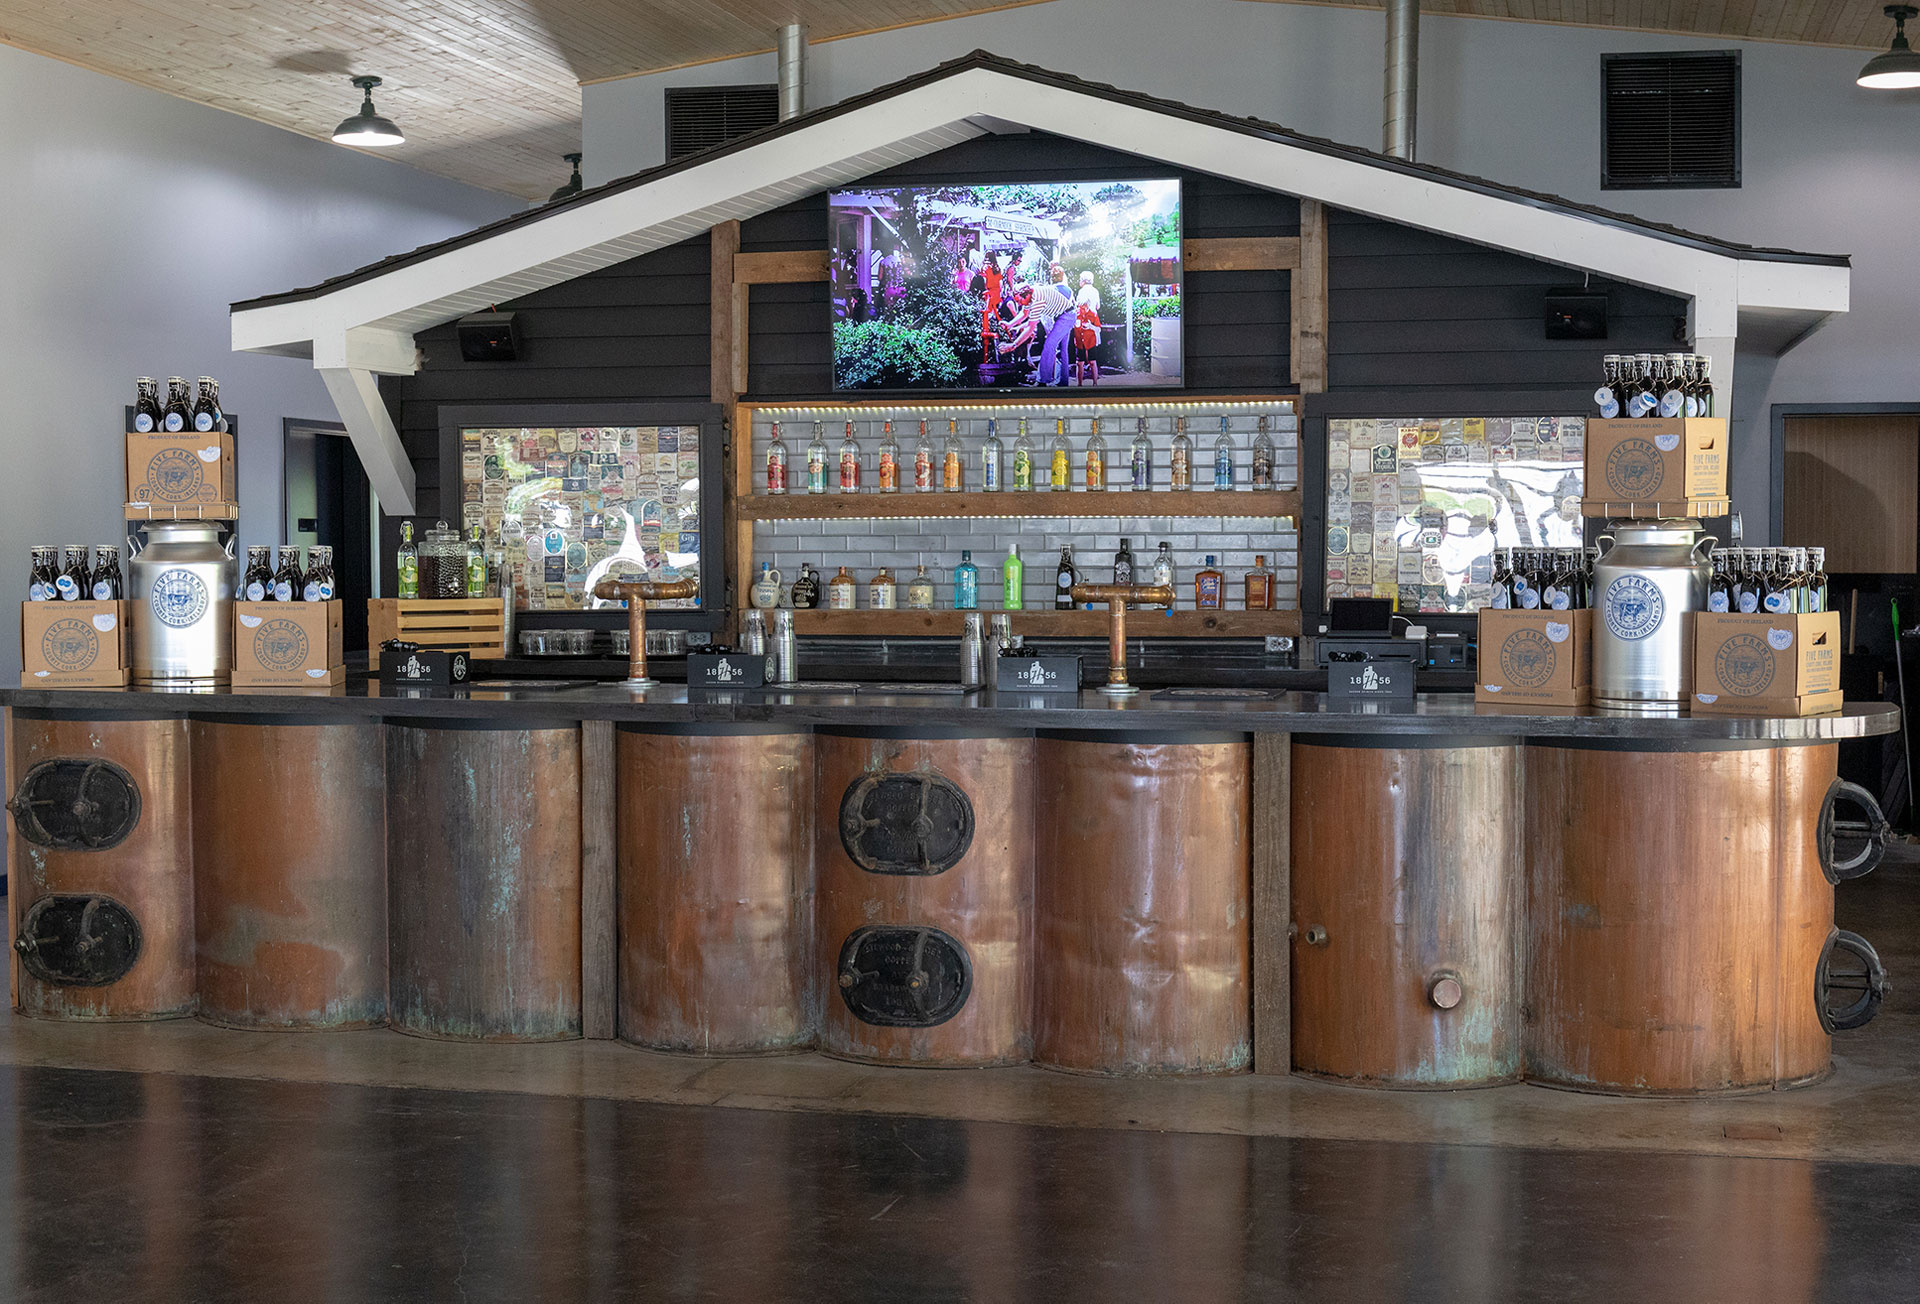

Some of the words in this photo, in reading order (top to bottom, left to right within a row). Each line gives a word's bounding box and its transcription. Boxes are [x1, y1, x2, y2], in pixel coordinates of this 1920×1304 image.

[151, 453, 168, 471] FIVE
[172, 451, 199, 471] FARMS
[1609, 444, 1629, 465] FIVE
[1633, 441, 1660, 465] FARMS
[139, 489, 150, 499] 97
[1607, 580, 1623, 602] FIVE
[1628, 578, 1660, 604] FARMS
[46, 623, 62, 642] FIVE
[68, 620, 95, 642] FARMS
[257, 623, 274, 642] FIVE
[279, 621, 306, 642] FARMS
[1504, 633, 1521, 653] FIVE
[1526, 631, 1553, 655] FARMS
[1719, 638, 1741, 661] FIVE
[1743, 636, 1772, 662] FARMS
